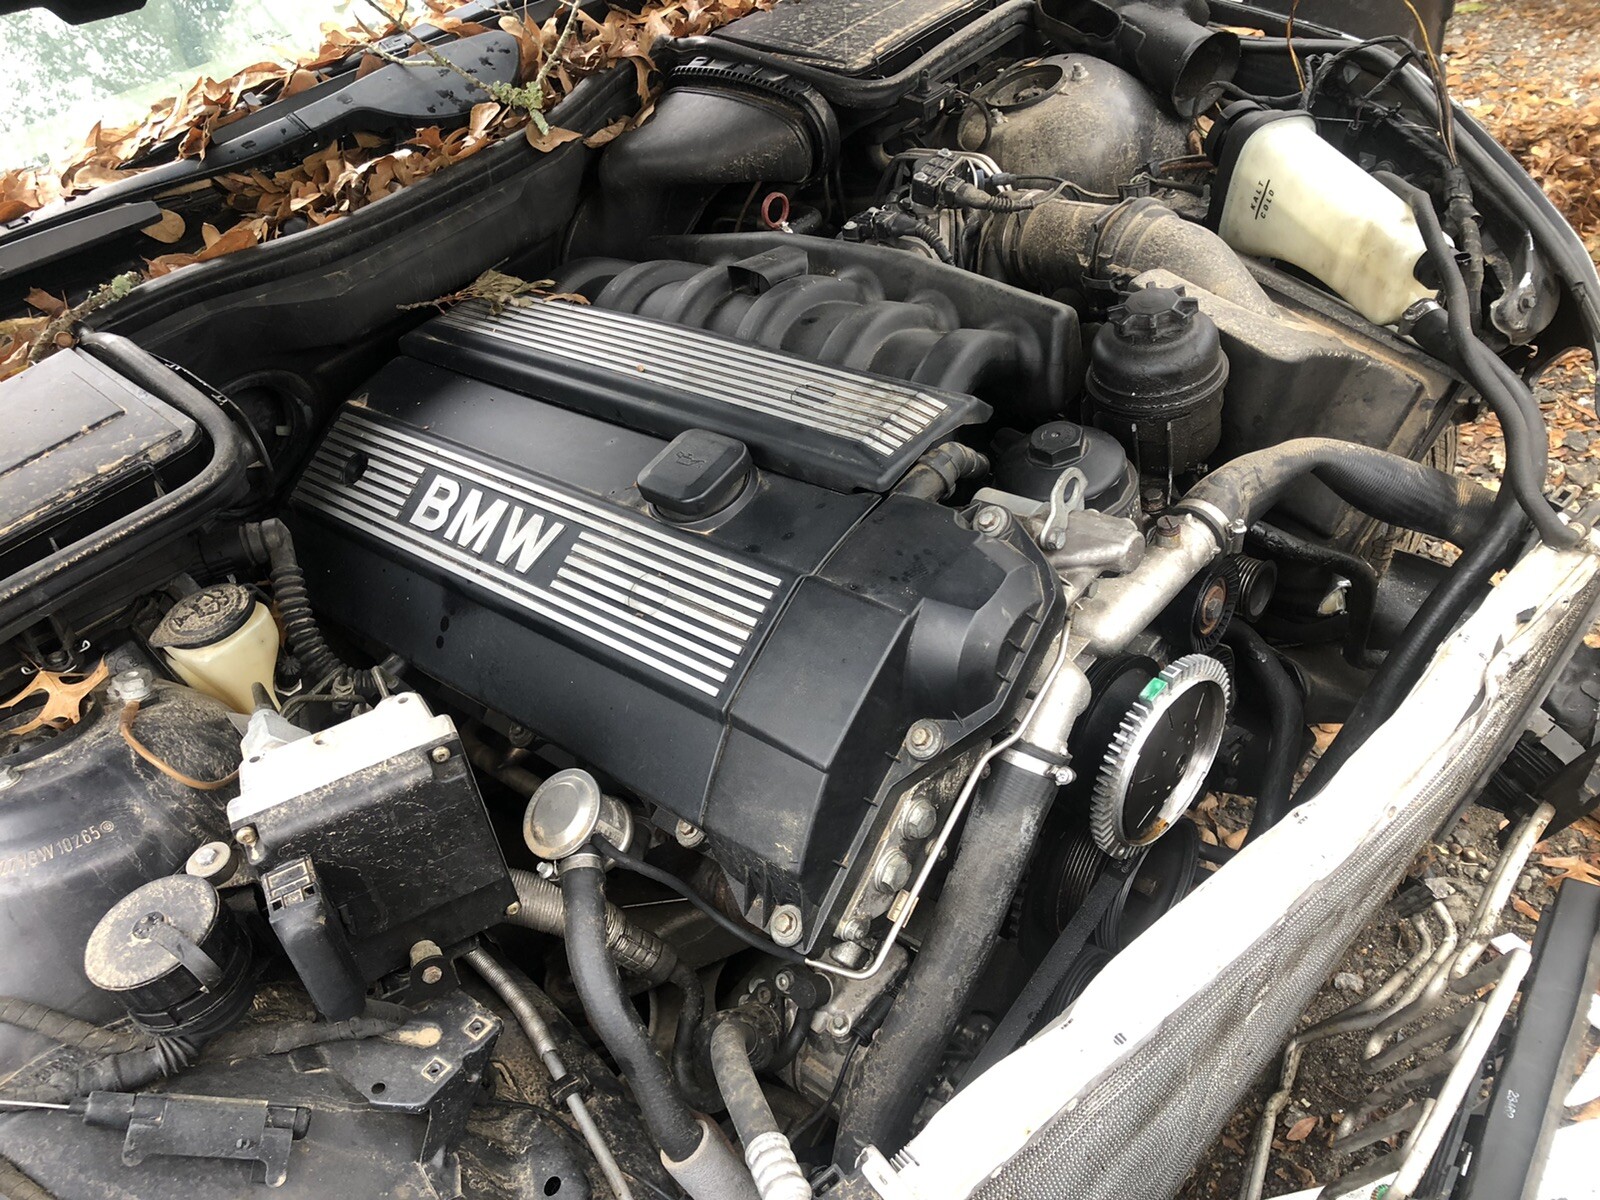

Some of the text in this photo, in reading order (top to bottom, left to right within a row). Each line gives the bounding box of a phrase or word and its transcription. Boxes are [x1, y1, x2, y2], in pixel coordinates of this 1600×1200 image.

[1250, 181, 1264, 211] KALT
[1260, 189, 1275, 219] COLD
[409, 474, 566, 575] BMW
